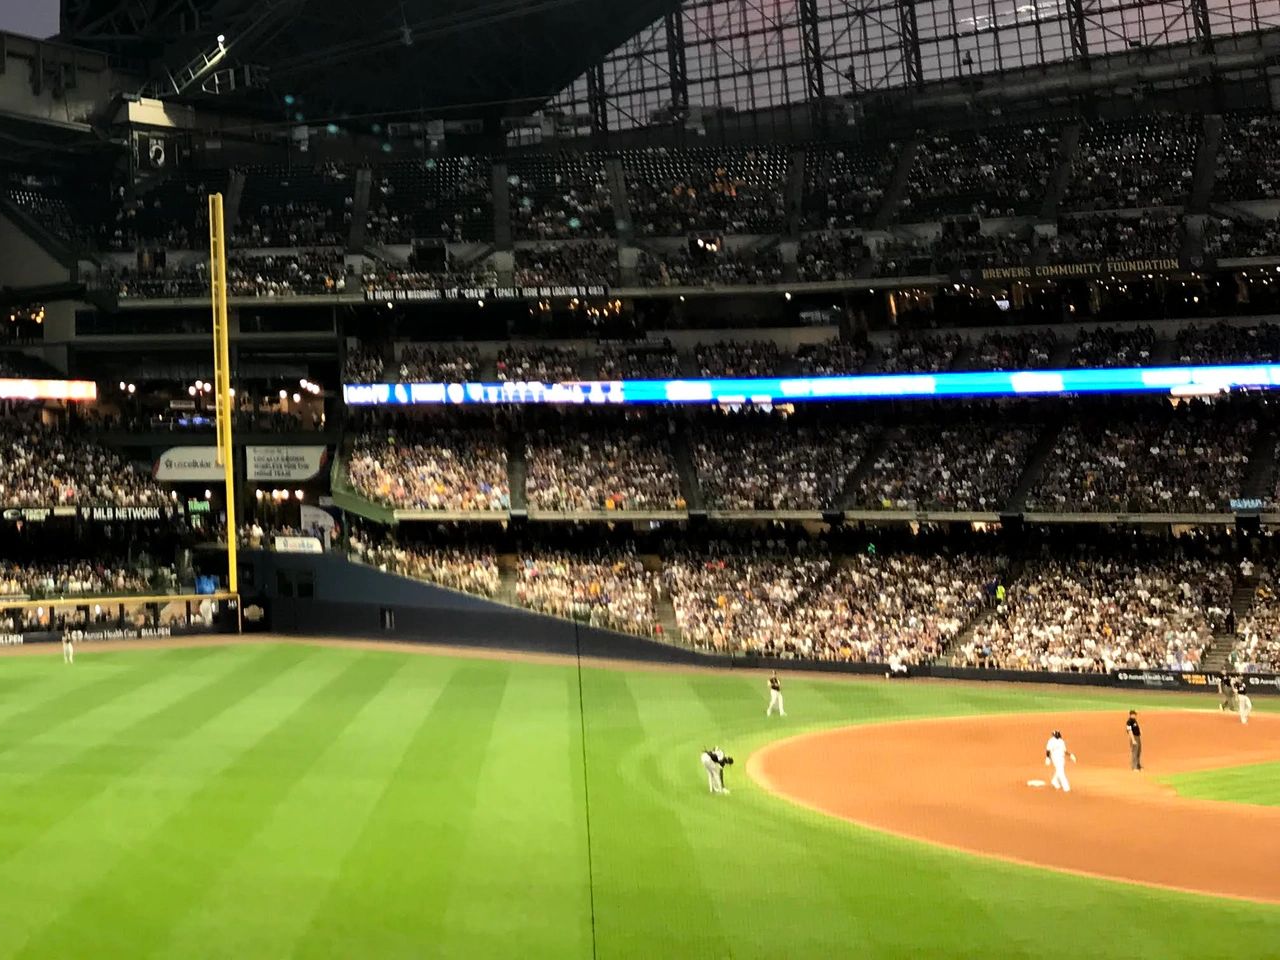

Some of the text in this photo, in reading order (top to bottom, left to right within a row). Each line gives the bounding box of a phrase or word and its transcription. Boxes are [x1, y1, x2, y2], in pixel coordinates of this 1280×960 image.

[982, 258, 1180, 280] BREWERS COMMUNITY FOUNDATION
[93, 506, 160, 520] MLB NETWORK
[83, 627, 171, 640] Aurora Health Care BULLPEN
